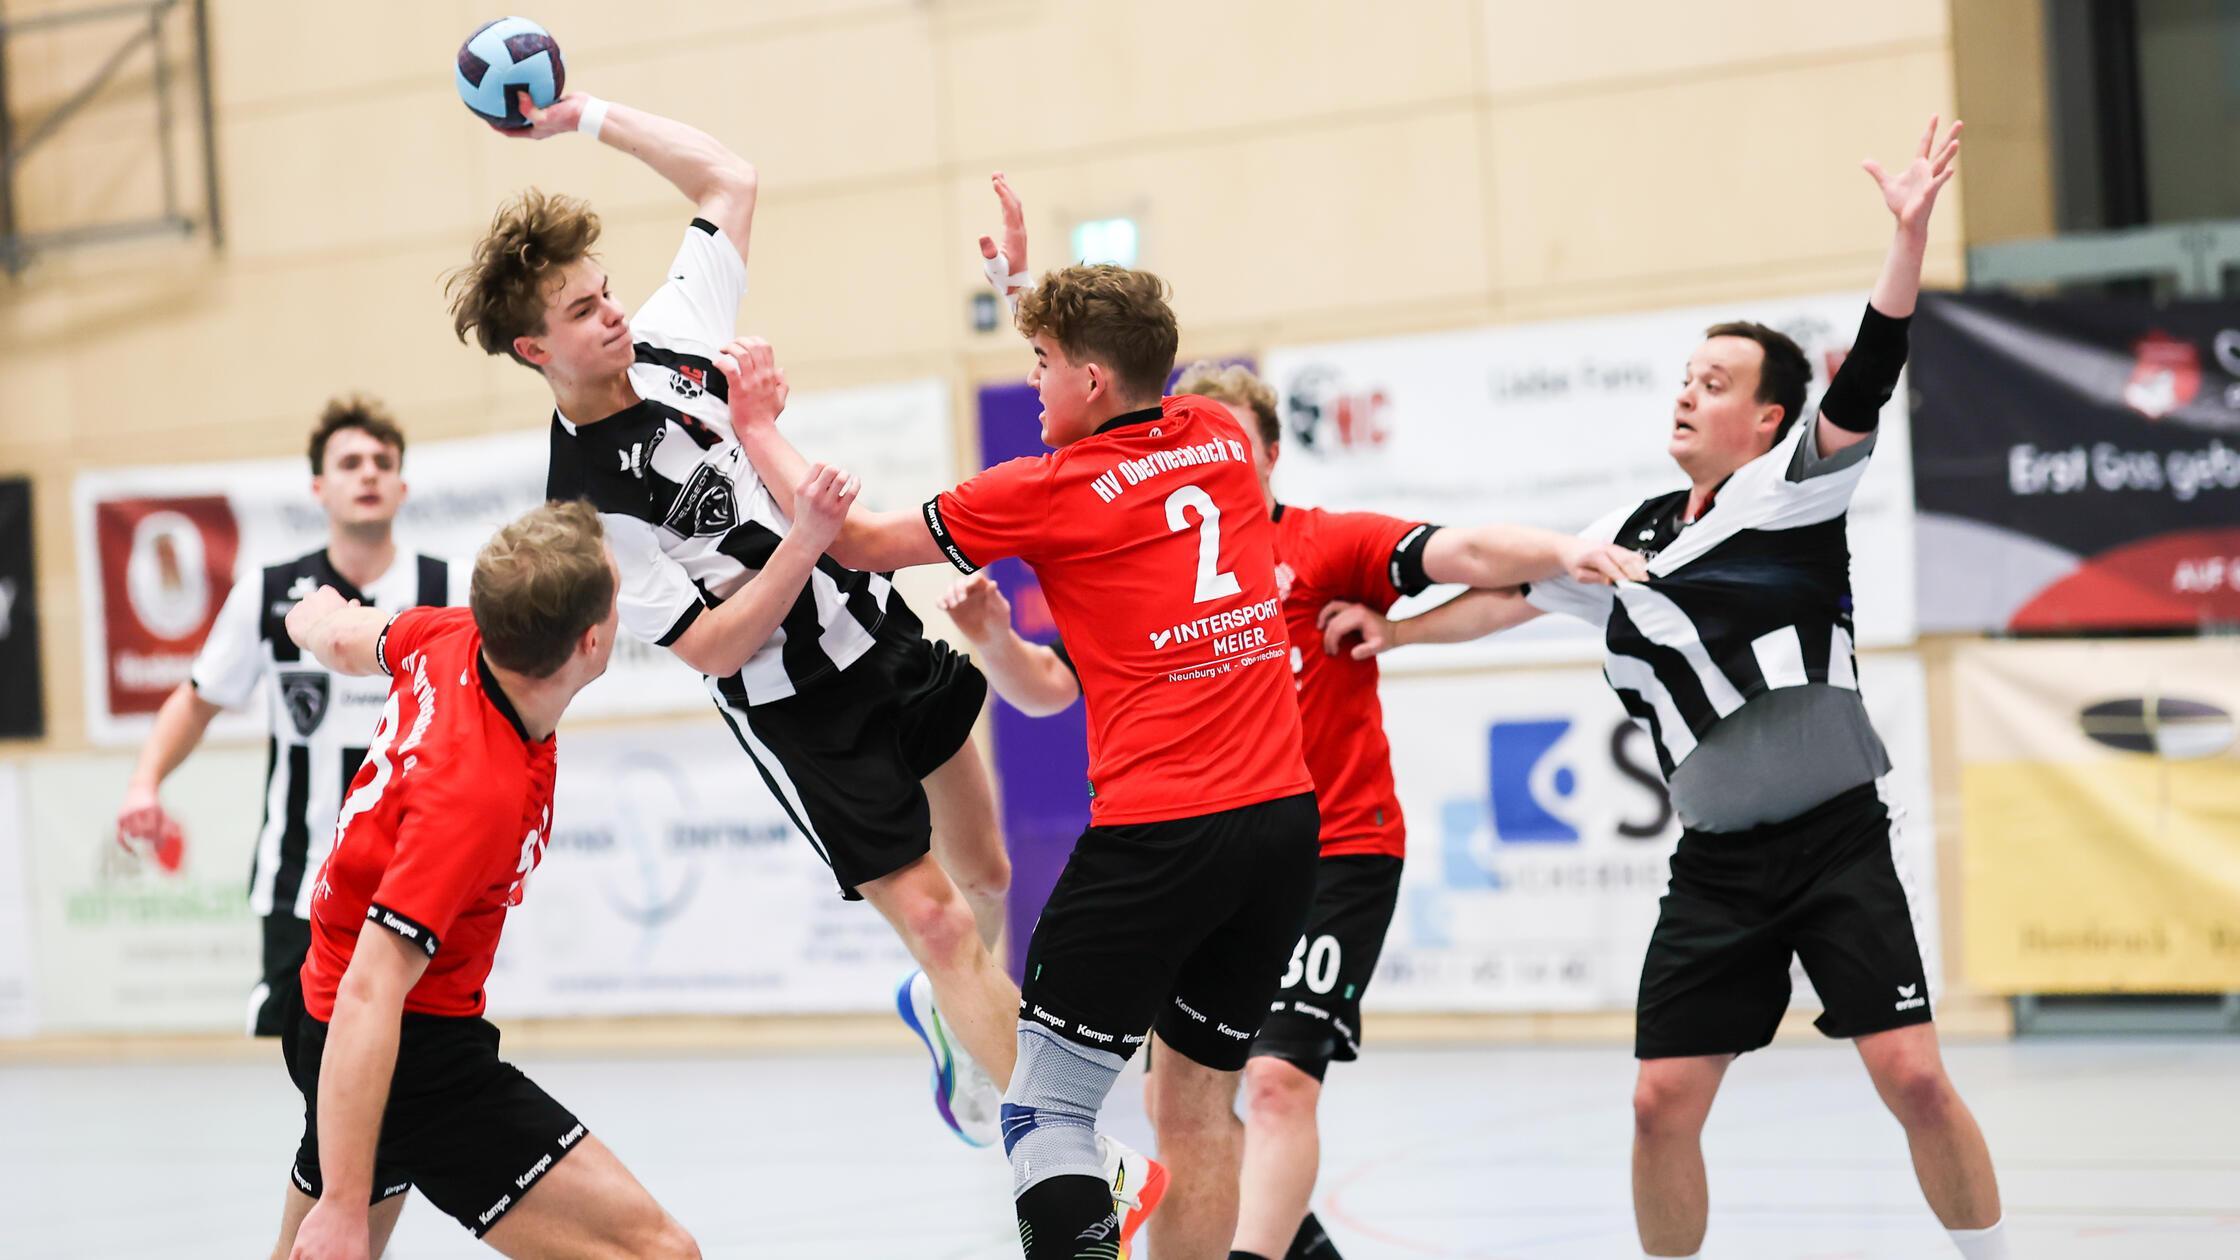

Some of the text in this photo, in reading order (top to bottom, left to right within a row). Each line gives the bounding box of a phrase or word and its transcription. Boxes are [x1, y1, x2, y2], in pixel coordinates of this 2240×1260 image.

[1090, 470, 1124, 504] HV
[1118, 437, 1229, 487] Oberviechtach
[927, 501, 944, 537] Kempa
[946, 544, 974, 573] Kempa
[1164, 484, 1242, 604] 2
[1173, 598, 1279, 644] INTERSPORT
[1213, 627, 1268, 657] MEIER
[1168, 667, 1217, 683] Neunburg
[383, 911, 418, 939] Kempa
[1280, 933, 1342, 995] 30
[1032, 1004, 1066, 1028] Kempa
[1076, 1023, 1114, 1043] Kempa
[1175, 995, 1250, 1040] Kempa Kempa
[479, 1123, 585, 1226] Kempa Kempa Kemp
